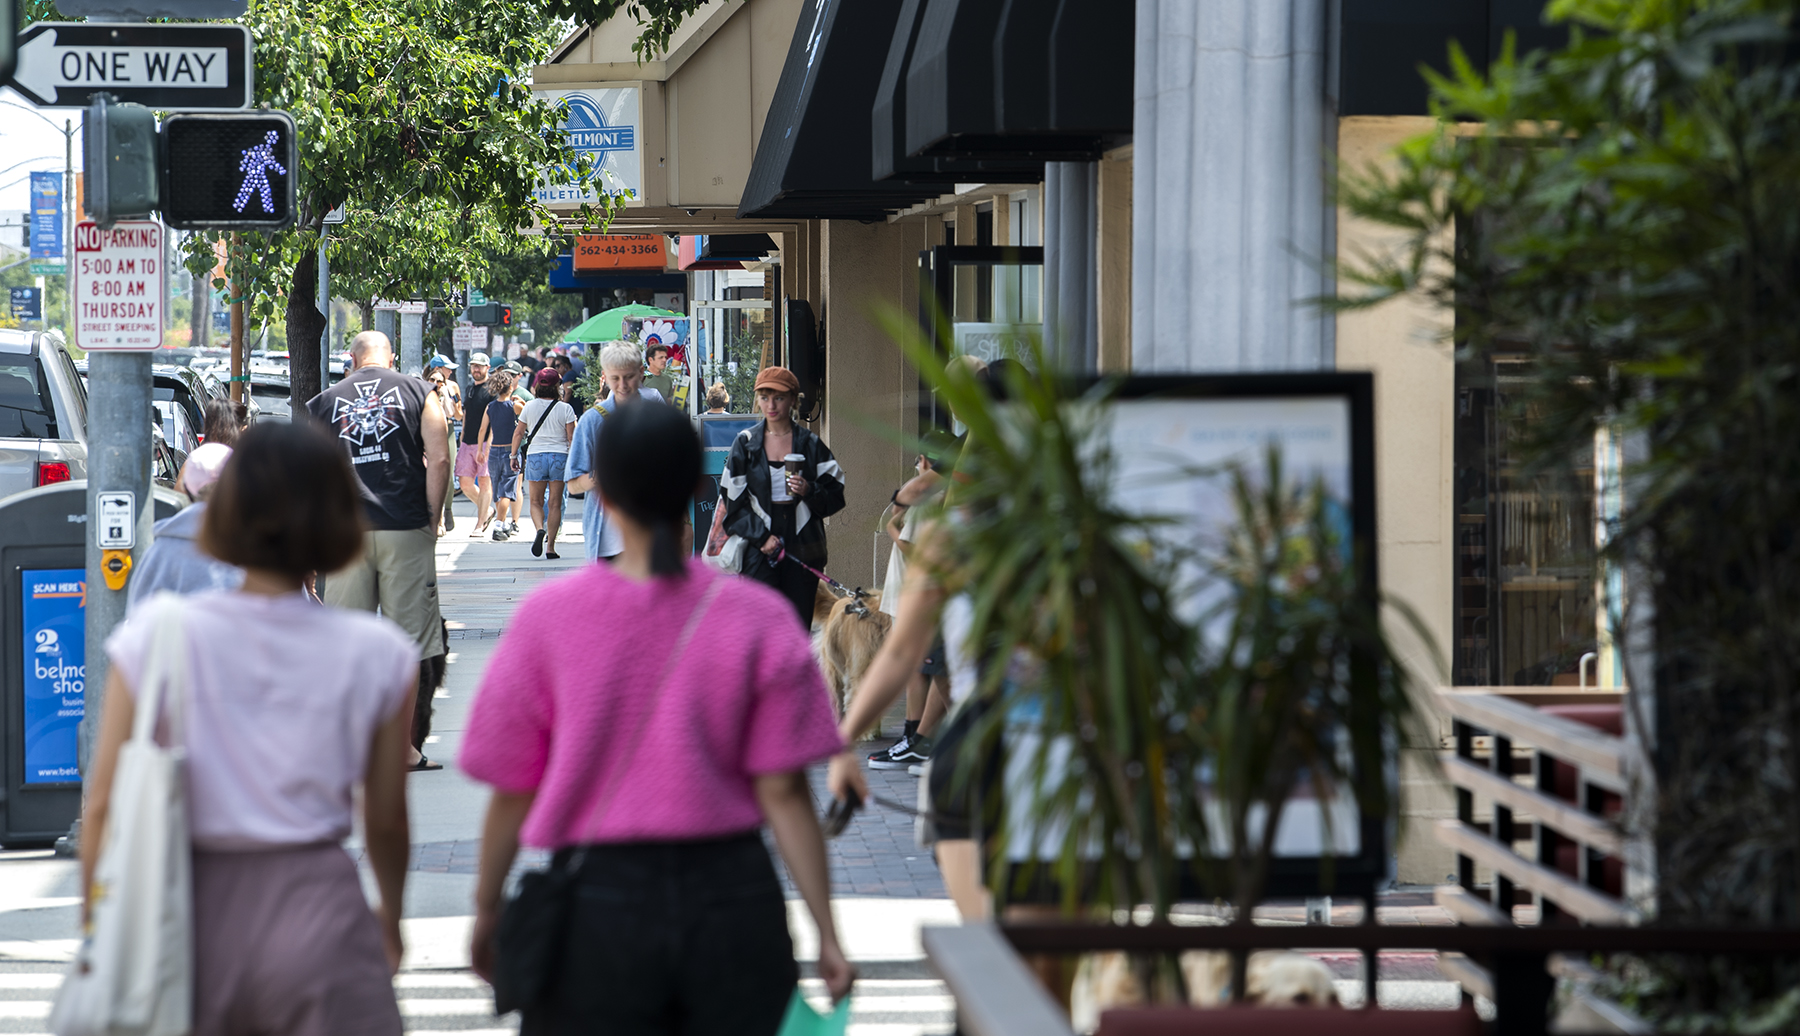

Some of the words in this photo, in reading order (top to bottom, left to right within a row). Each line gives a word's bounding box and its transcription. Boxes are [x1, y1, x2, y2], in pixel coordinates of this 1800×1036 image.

[61, 51, 130, 82] ONE
[144, 52, 217, 82] WAY
[563, 132, 620, 147] BELMONT
[526, 190, 592, 201] THLETIC
[77, 226, 100, 249] NO
[103, 229, 157, 248] PARKING
[82, 259, 112, 275] 5:00
[116, 259, 135, 274] AM
[141, 259, 156, 274] TO
[91, 280, 122, 296] 8:00
[126, 280, 145, 296] AM
[82, 302, 155, 318] THURSDAY
[82, 323, 112, 332] STREET
[114, 323, 156, 332] SWEEPING
[33, 583, 57, 593] SCAN
[58, 582, 79, 592] HERE
[35, 628, 59, 653] 2
